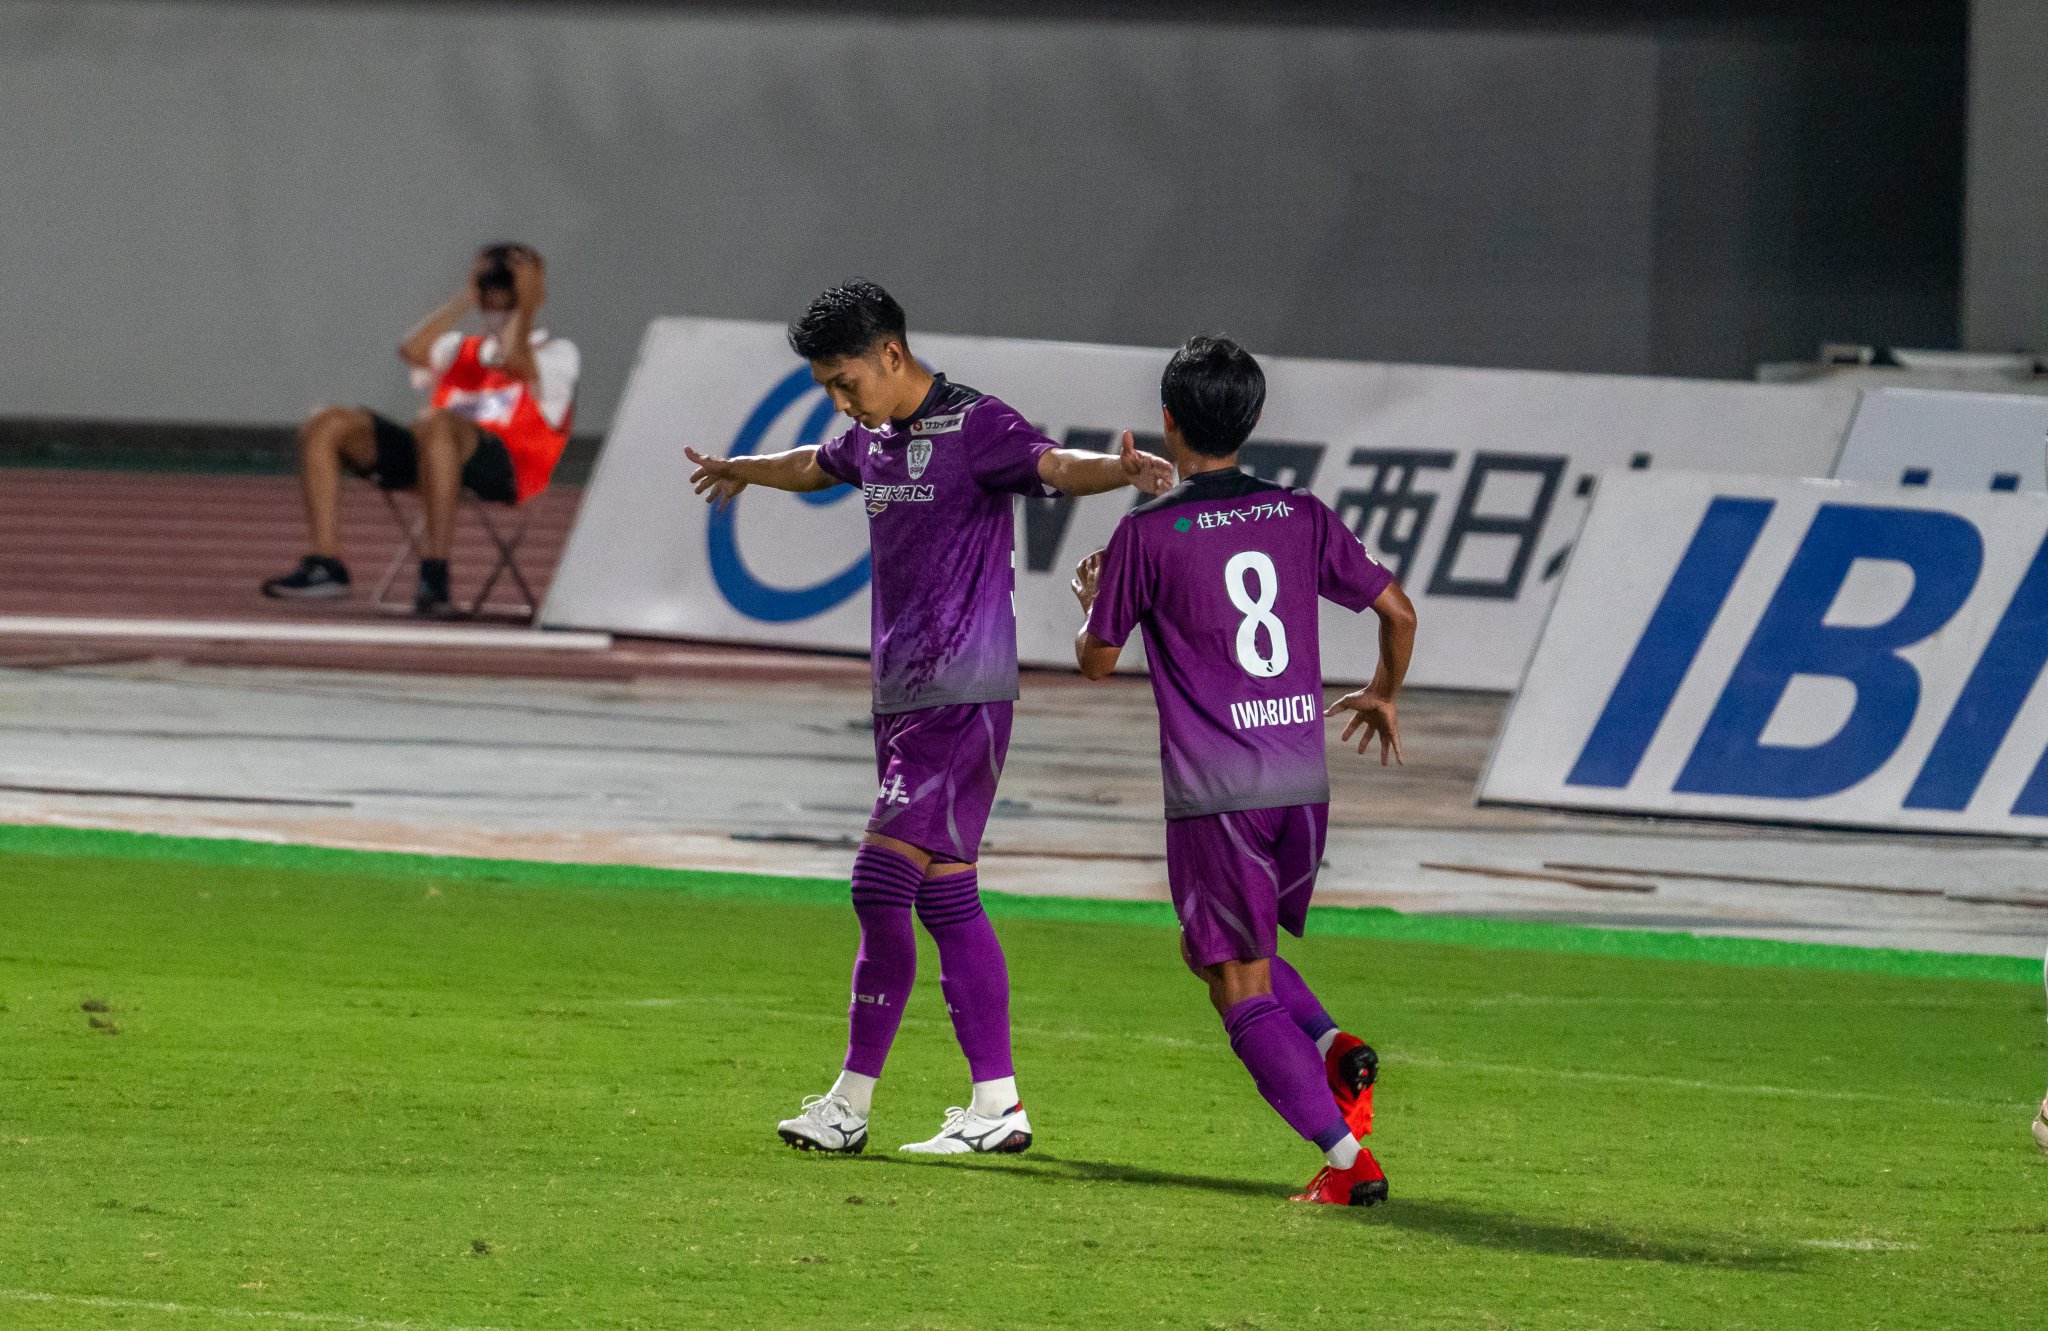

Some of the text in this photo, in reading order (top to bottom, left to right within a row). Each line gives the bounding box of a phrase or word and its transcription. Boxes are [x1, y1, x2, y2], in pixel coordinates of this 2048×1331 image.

[925, 418, 962, 430] サカイ
[1197, 501, 1294, 529] 住友ベークライト
[1224, 550, 1290, 678] 8
